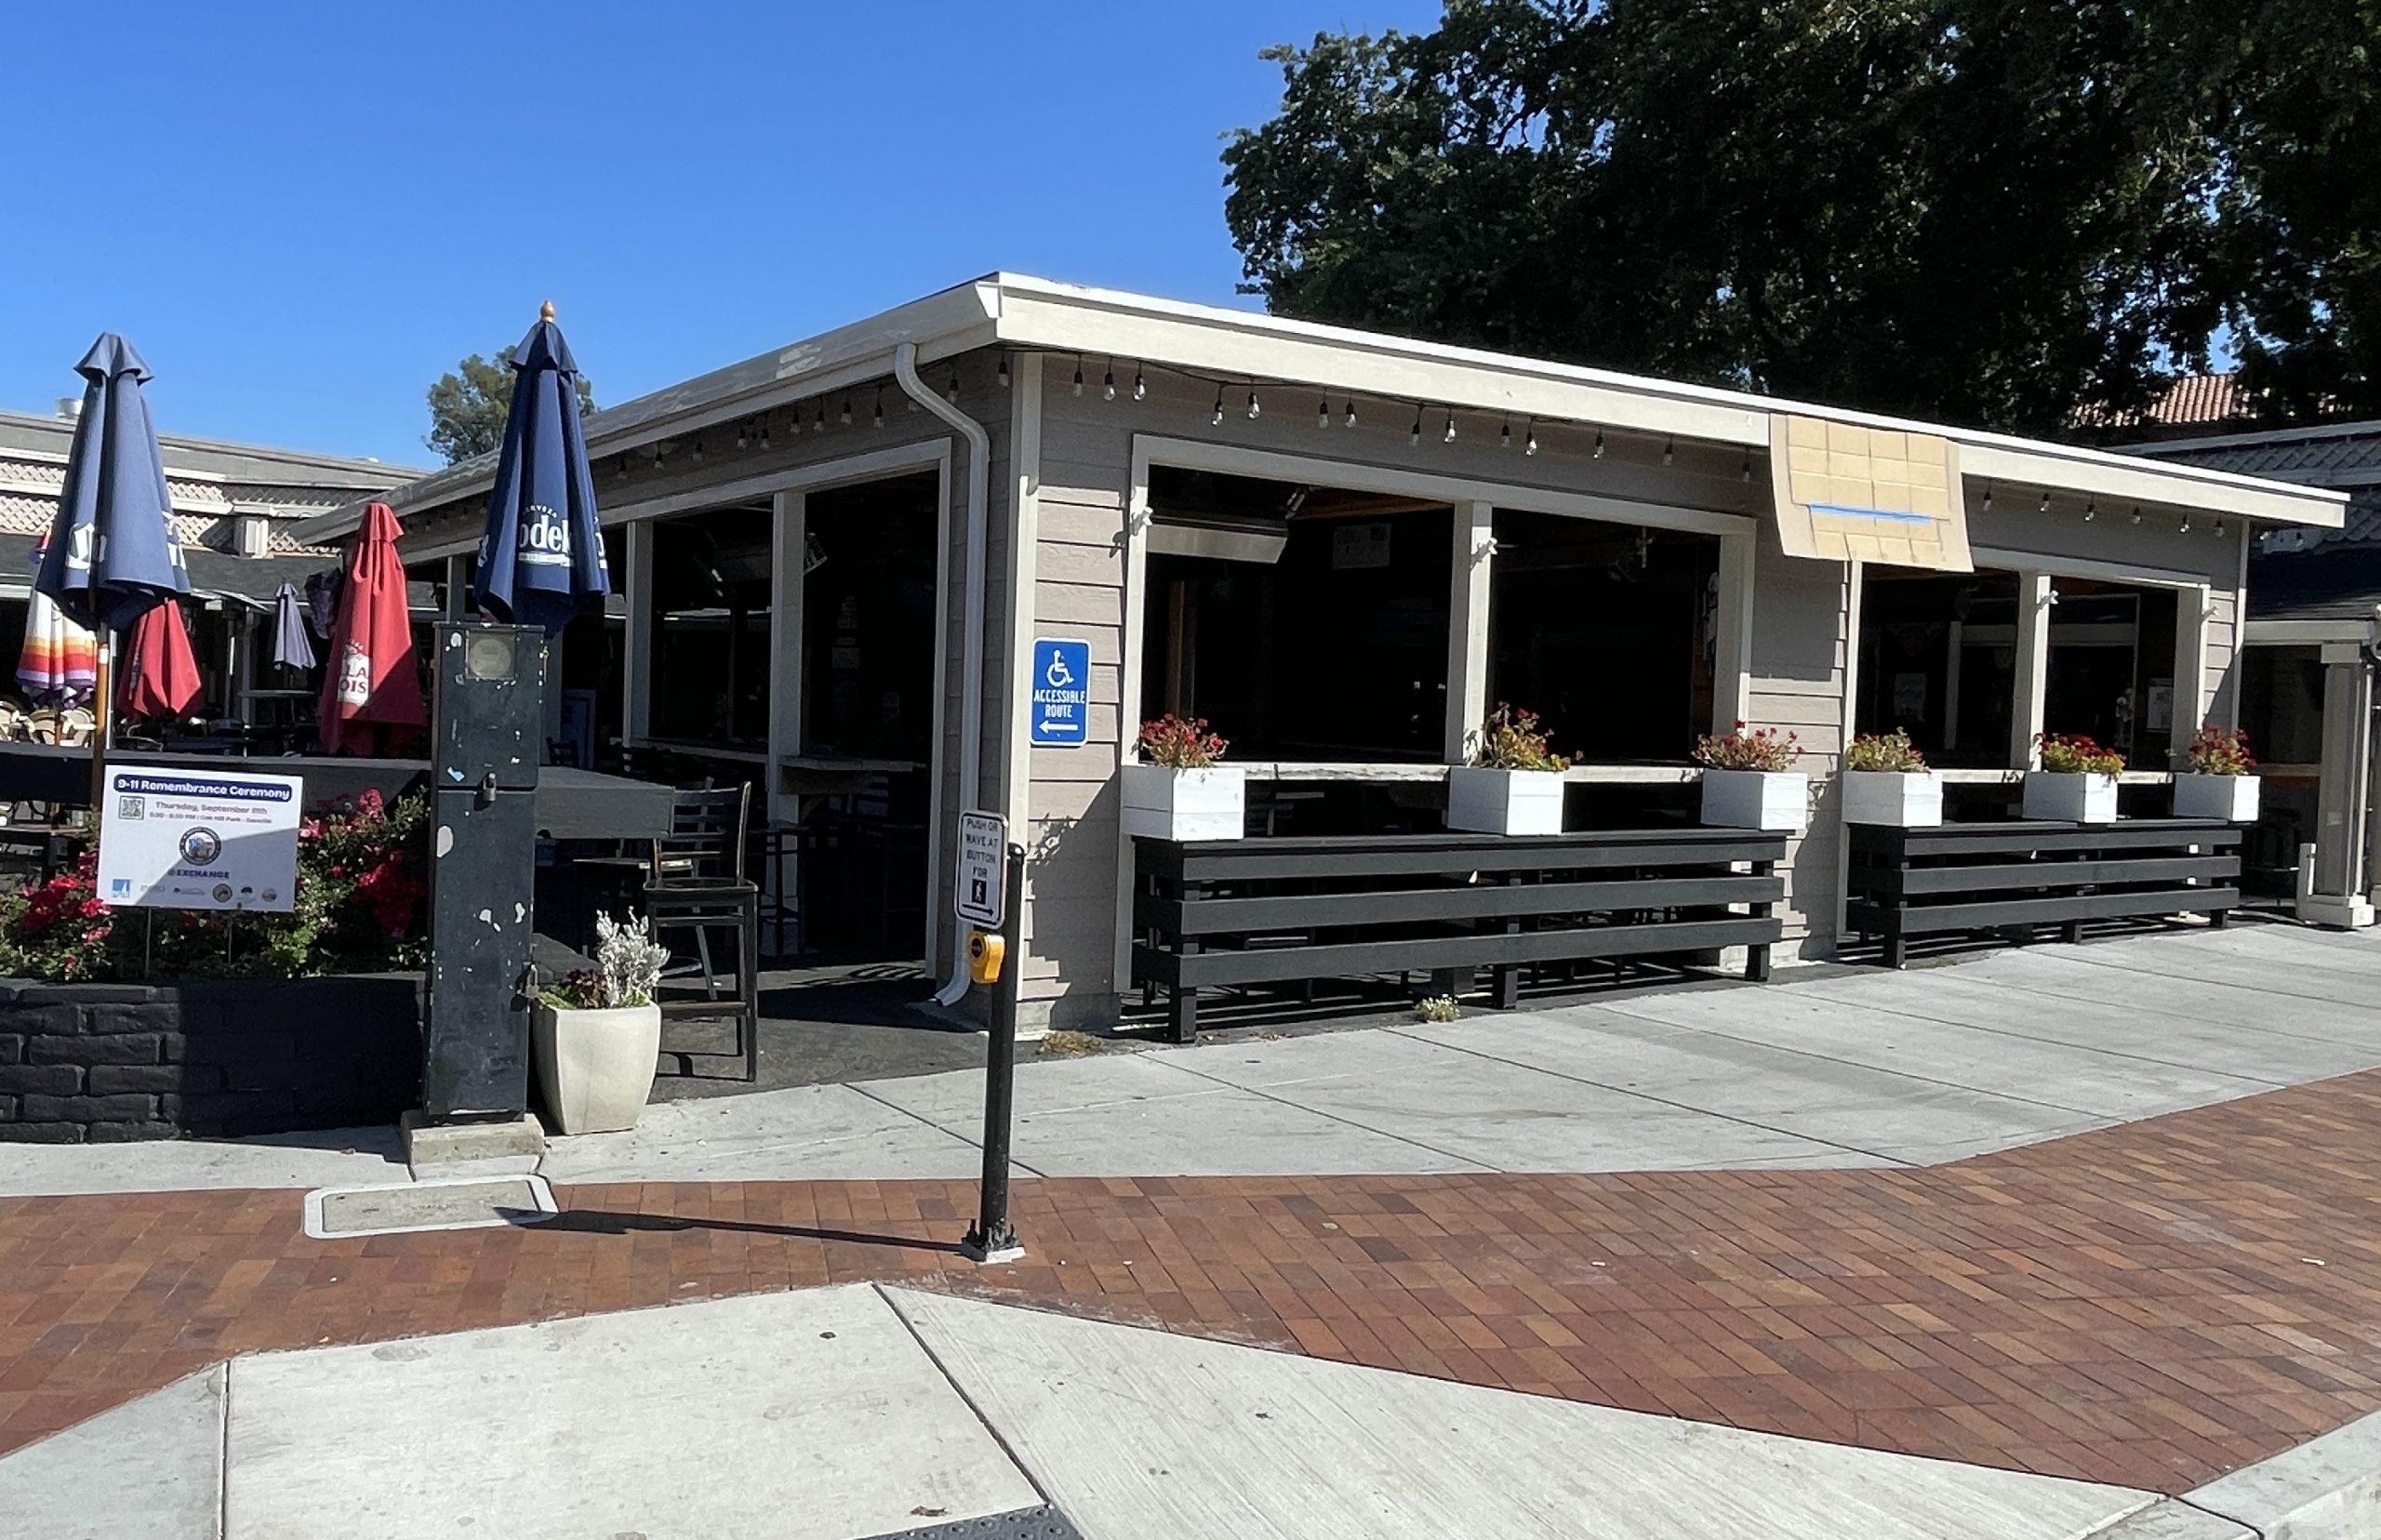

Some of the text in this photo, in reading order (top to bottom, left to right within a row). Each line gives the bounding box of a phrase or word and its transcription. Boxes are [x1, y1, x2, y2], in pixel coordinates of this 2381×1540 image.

[339, 679, 367, 694] OIS
[1033, 689, 1085, 704] ACCESSIBLE
[1044, 704, 1073, 718] ROUTE
[117, 778, 290, 801] 9-11 Remembrance Ceremony
[154, 801, 199, 812] Thursday,
[200, 803, 249, 815] September
[966, 817, 999, 832] PUSH OR
[965, 833, 999, 848] WAVE AT
[966, 849, 996, 864] BUTTON
[176, 869, 230, 880] EXCHANGE
[973, 866, 988, 878] FOR
